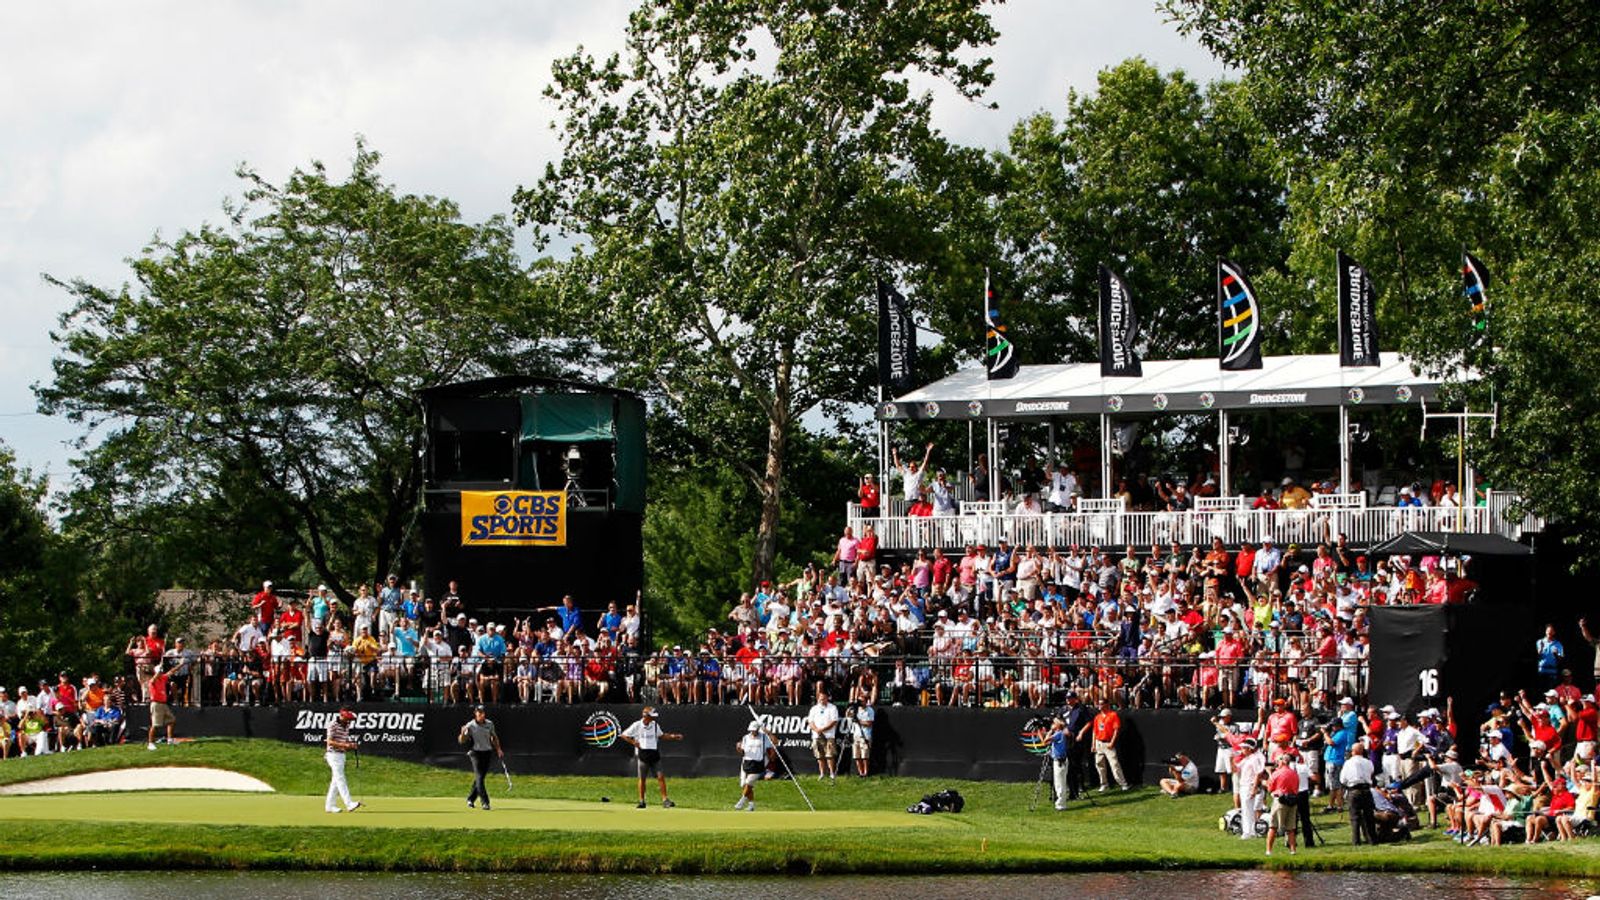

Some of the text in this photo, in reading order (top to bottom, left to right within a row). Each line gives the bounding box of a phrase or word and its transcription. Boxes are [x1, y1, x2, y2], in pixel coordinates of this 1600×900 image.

[513, 496, 560, 515] CBS
[470, 515, 558, 540] SPORTS
[1419, 668, 1439, 697] 16
[303, 732, 323, 742] Your
[363, 732, 380, 742] Our
[381, 732, 415, 742] Passion
